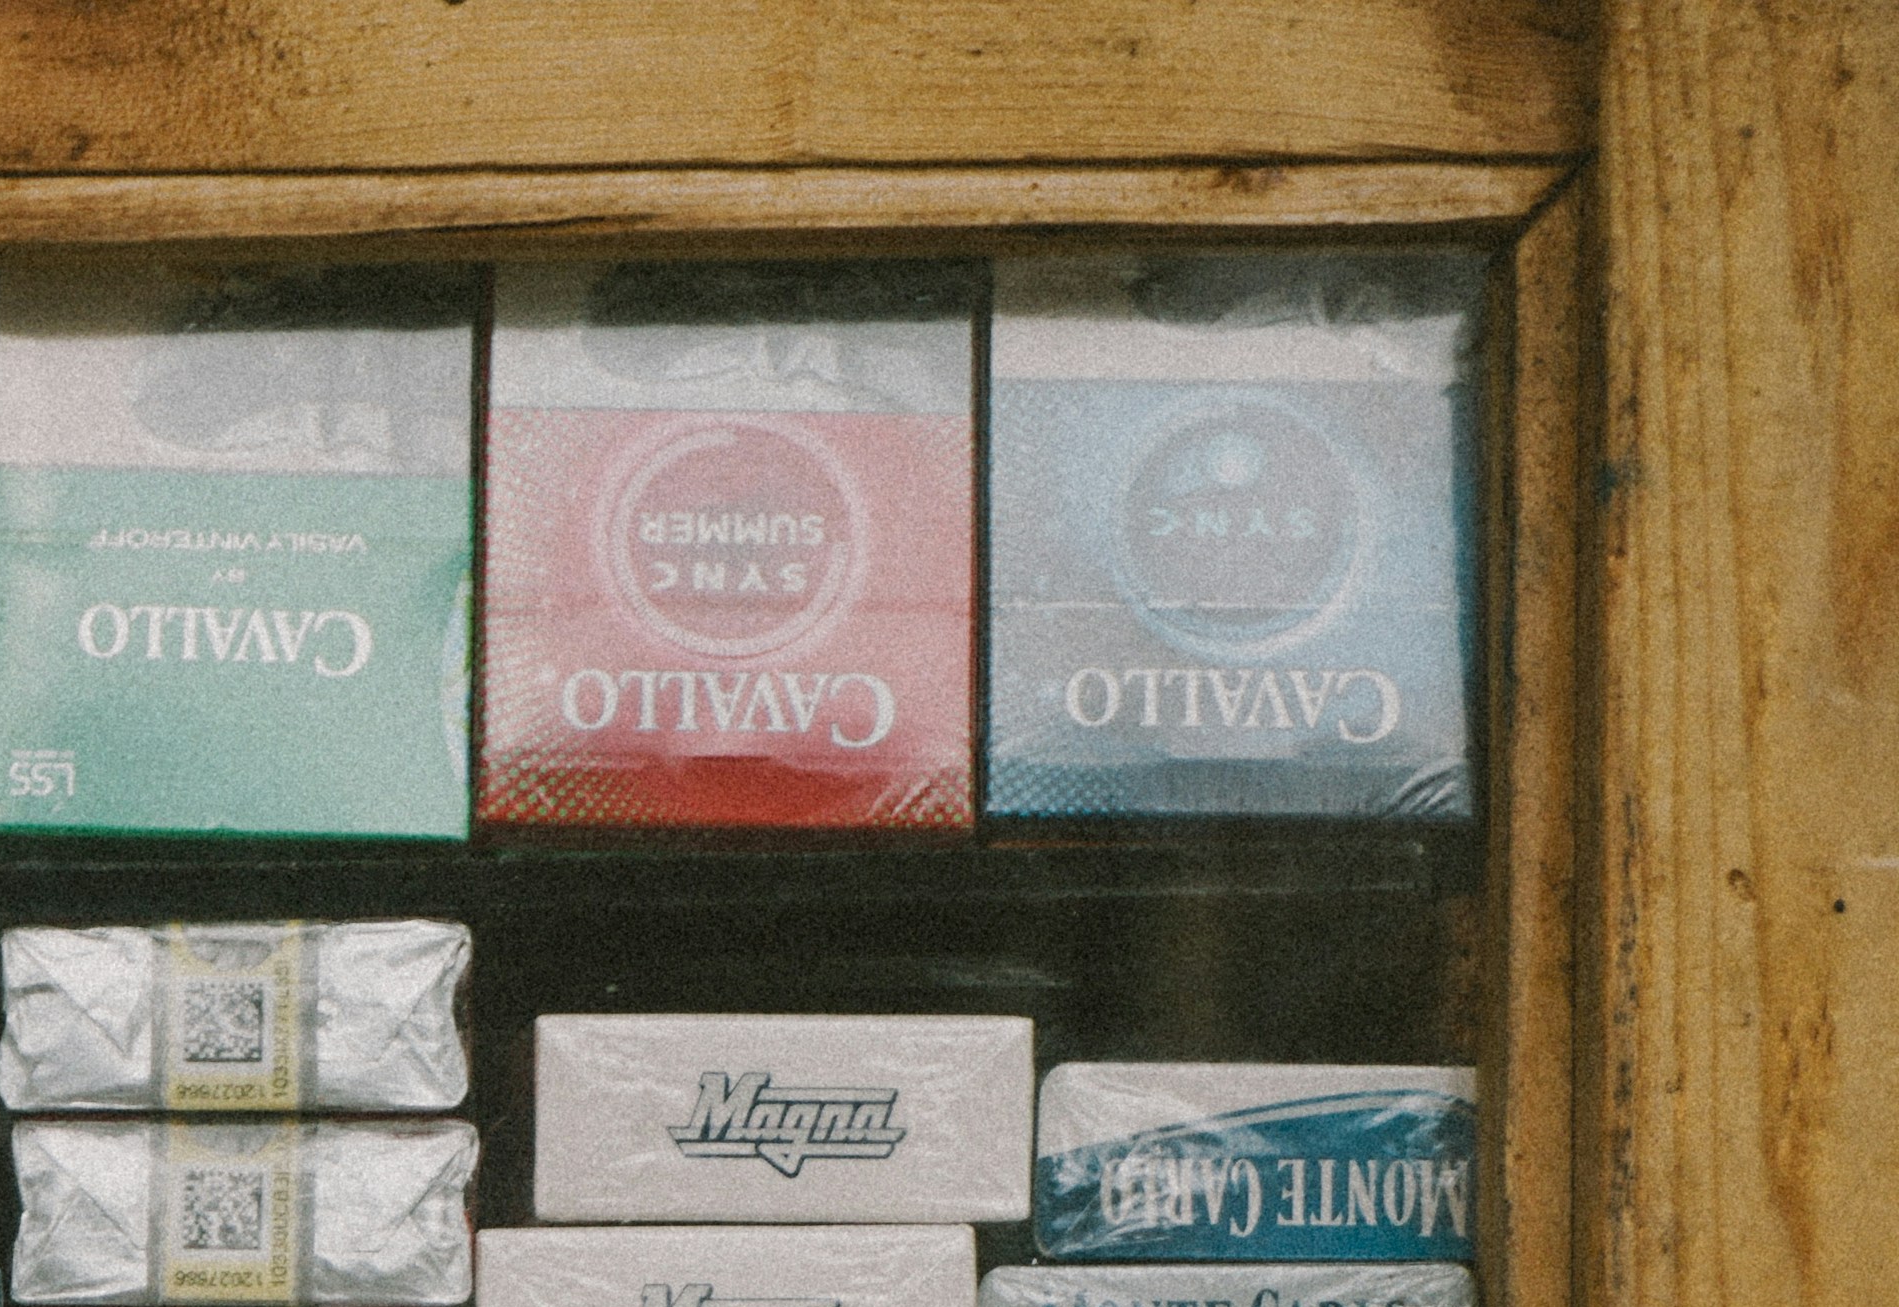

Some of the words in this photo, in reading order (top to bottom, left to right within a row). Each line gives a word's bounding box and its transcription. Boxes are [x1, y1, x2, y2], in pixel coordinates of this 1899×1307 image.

[642, 512, 825, 546] SUMMER
[1149, 508, 1314, 536] SYNC
[652, 564, 806, 591] SYNC
[78, 603, 370, 678] CAVALLO
[562, 670, 894, 748] CAVALLO
[1067, 667, 1398, 744] CAVALLO
[11, 763, 75, 796] LSS
[679, 1071, 902, 1172] Magna
[1103, 1158, 1261, 1238] CARLO
[1279, 1158, 1469, 1238] MONTE
